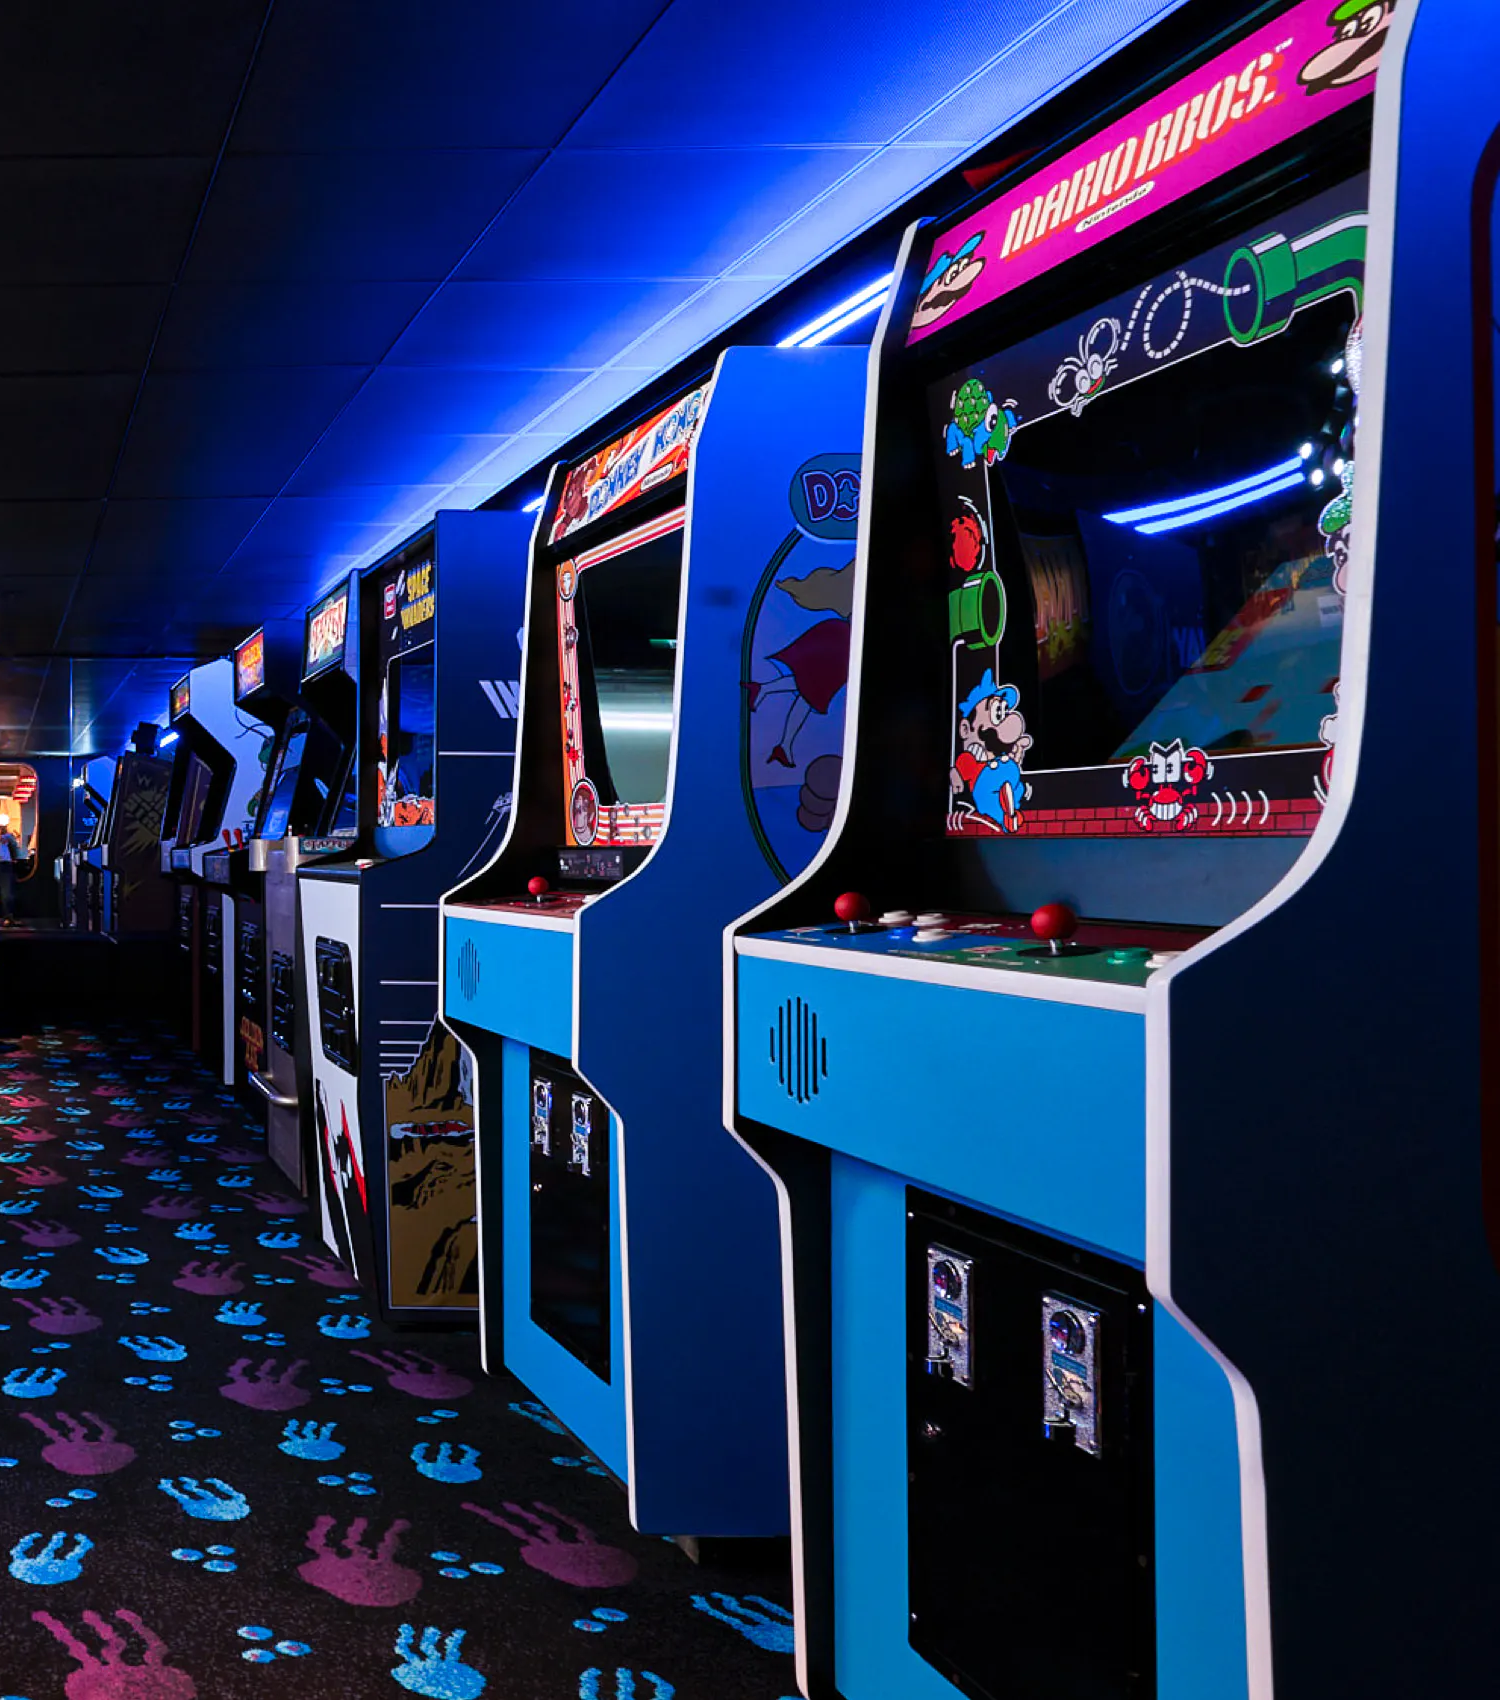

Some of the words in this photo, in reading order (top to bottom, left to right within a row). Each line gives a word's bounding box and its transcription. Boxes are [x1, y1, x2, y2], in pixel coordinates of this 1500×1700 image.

[1000, 136, 1138, 260] MARIO
[1133, 52, 1277, 182] BROS.
[589, 437, 649, 518] DONKEY
[400, 590, 435, 630] INVADERS
[406, 561, 432, 603] SPACE
